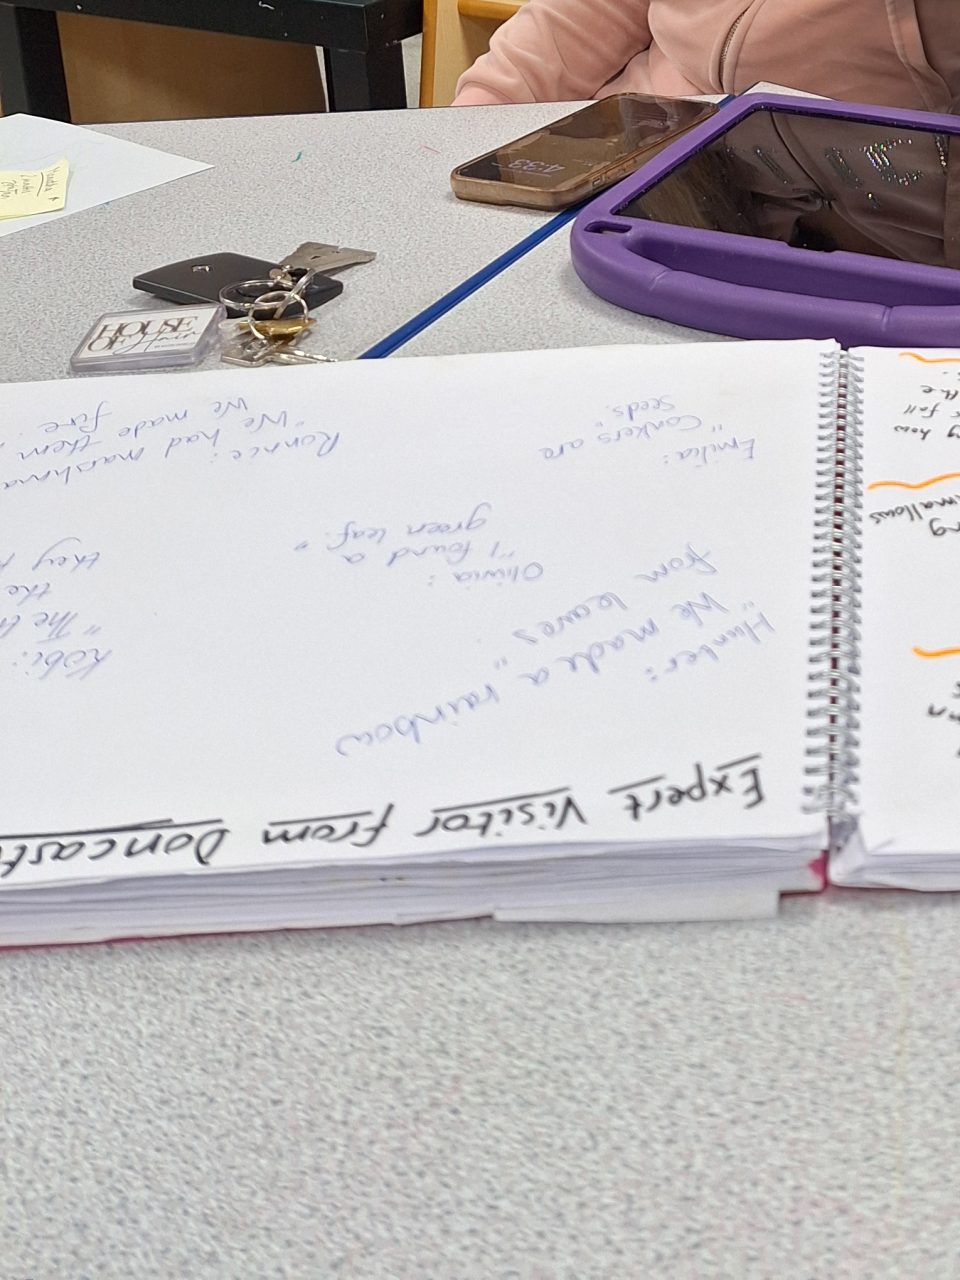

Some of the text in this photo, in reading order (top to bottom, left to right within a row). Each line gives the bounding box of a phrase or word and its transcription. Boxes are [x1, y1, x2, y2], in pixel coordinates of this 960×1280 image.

[507, 159, 565, 174] 4:33
[95, 316, 198, 338] HOUSE
[88, 335, 129, 352] OF
[920, 385, 959, 400] the
[903, 402, 940, 418] fall
[18, 397, 248, 460] We made them
[893, 425, 932, 440] how
[164, 429, 221, 459] had
[538, 438, 585, 462] are
[406, 502, 492, 536] green
[31, 536, 100, 574] they
[341, 552, 366, 566] a
[386, 540, 470, 567] found
[634, 542, 718, 583] from
[4, 582, 51, 607] the
[553, 618, 659, 676] made
[518, 666, 550, 687] a
[335, 684, 500, 757] rainbow
[0, 762, 764, 878] Expert Visitor from Doncast
